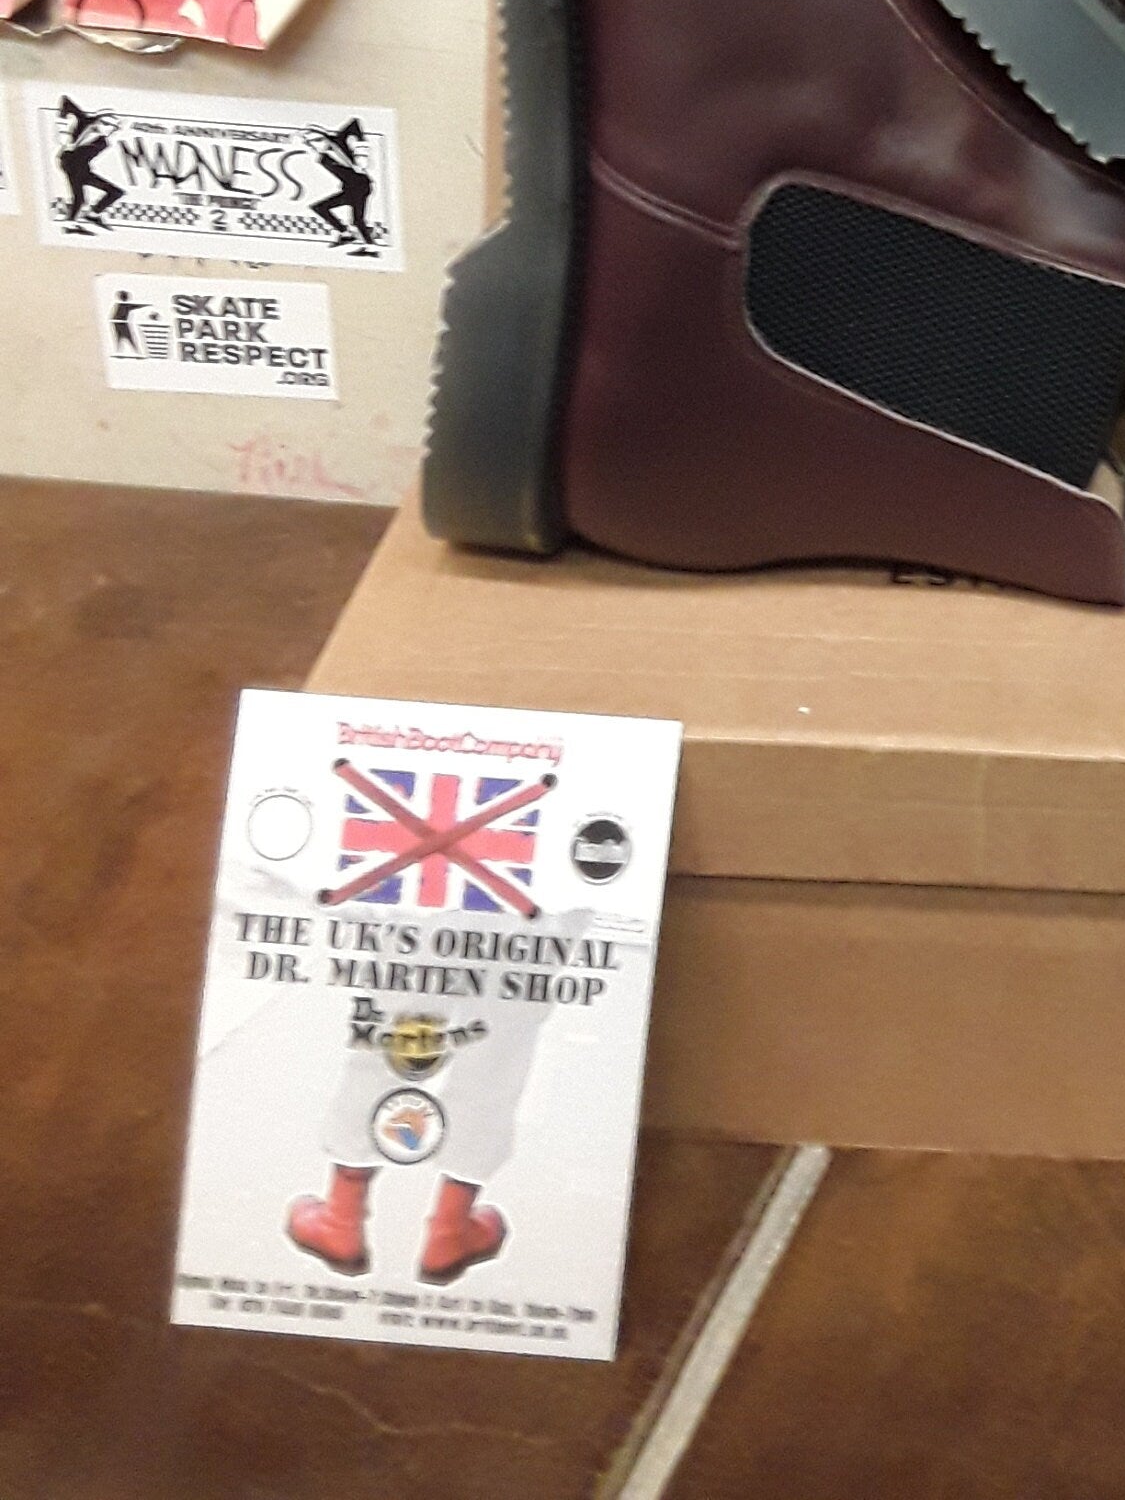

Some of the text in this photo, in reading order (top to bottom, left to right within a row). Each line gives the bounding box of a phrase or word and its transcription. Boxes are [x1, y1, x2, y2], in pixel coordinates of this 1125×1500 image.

[118, 137, 308, 201] MADNESS
[172, 295, 281, 320] SKATE
[176, 318, 269, 343] PARK
[179, 342, 329, 370] RESPECT
[236, 912, 619, 970] THE UK'S ORIGINAL
[245, 950, 608, 1007] DR. MARTEN SHOP
